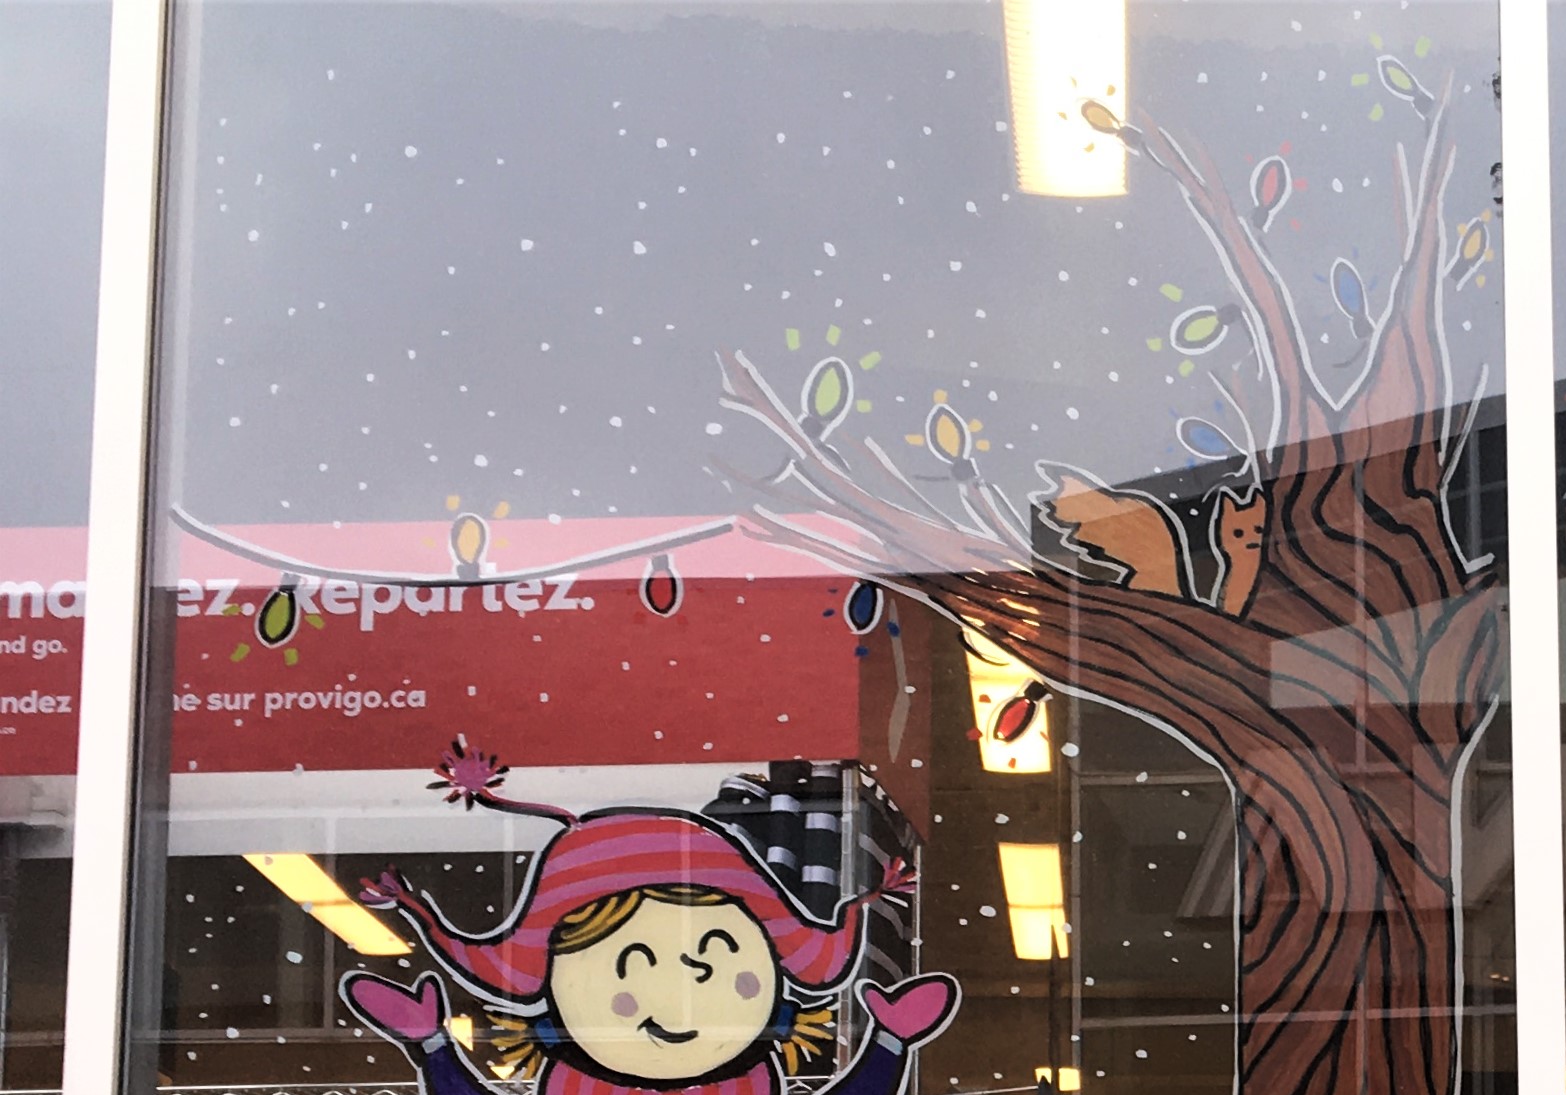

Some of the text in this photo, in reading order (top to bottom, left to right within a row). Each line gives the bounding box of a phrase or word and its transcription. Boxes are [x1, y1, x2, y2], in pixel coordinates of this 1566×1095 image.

[32, 638, 68, 661] go.
[206, 692, 255, 711] sur
[264, 684, 427, 718] provigo.ca
